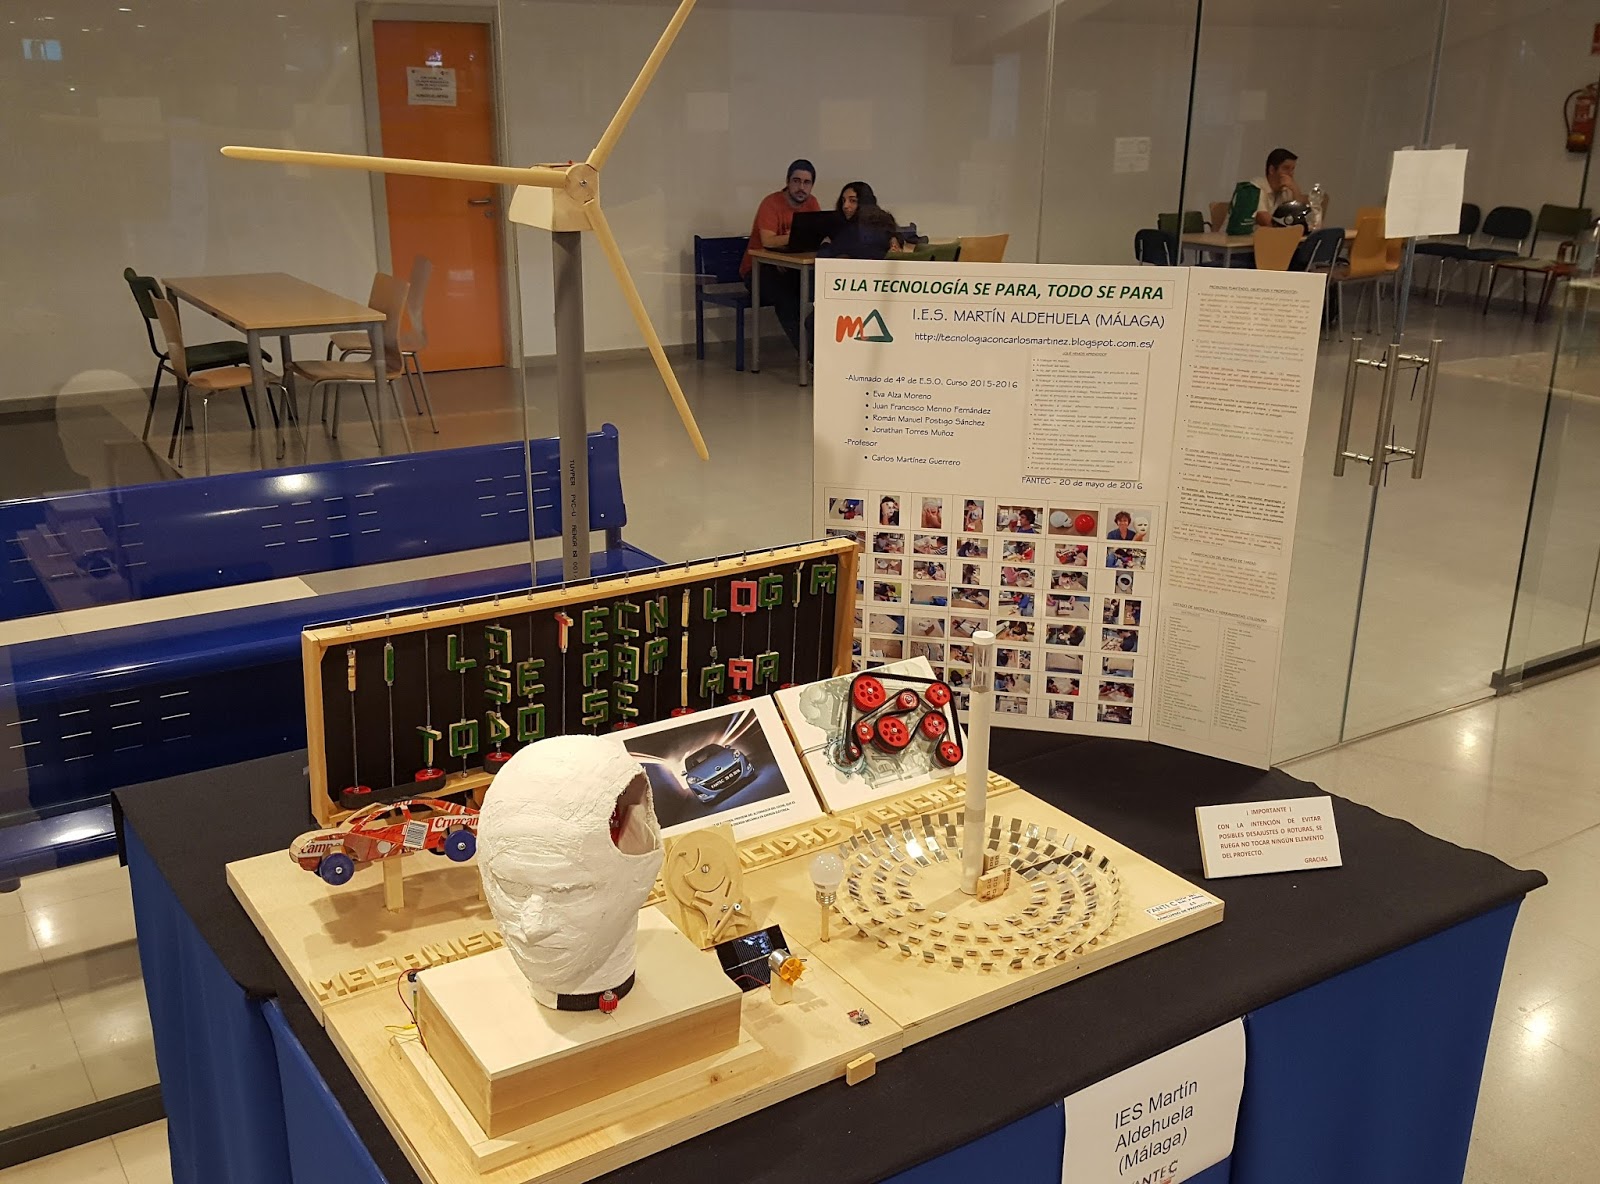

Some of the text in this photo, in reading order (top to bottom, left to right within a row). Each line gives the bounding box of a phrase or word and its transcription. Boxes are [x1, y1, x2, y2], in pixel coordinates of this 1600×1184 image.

[833, 278, 1164, 300] SI LA TECNOLOGÍA SE PARA, TODO SE PARA
[913, 308, 1165, 329] I.E.S. MARTÍN ALDEHUELA (MÁLAGA)
[946, 379, 968, 387] Curso
[970, 380, 1018, 389] 2015-2016
[873, 390, 932, 400] Eva Alza Moreno
[890, 404, 925, 412] Francisco
[954, 405, 991, 415] Fernández
[872, 414, 896, 422] Román
[897, 415, 923, 424] Manuel
[955, 417, 985, 427] Sánchez
[872, 426, 954, 437] Jonathan Torres Muñoz
[871, 454, 961, 466] Carlos Martínez Guerrero
[1021, 476, 1051, 485] FANTEC
[1059, 478, 1071, 486] 20
[1085, 481, 1105, 489] mayo
[1107, 481, 1117, 489] de
[1119, 481, 1143, 490] 2016
[1251, 806, 1287, 815] IMPORTANTE
[1250, 819, 1281, 827] INTENCIÓN
[1219, 831, 1245, 840] POSIBLES
[1246, 829, 1279, 838] DESAJUSTES
[1295, 834, 1325, 843] ELEMENTO
[1304, 856, 1328, 864] GRACIAS
[1115, 1080, 1198, 1130] IES Martín
[1114, 1104, 1194, 1153] Aldehuela
[1118, 1126, 1188, 1176] (Málaga)
